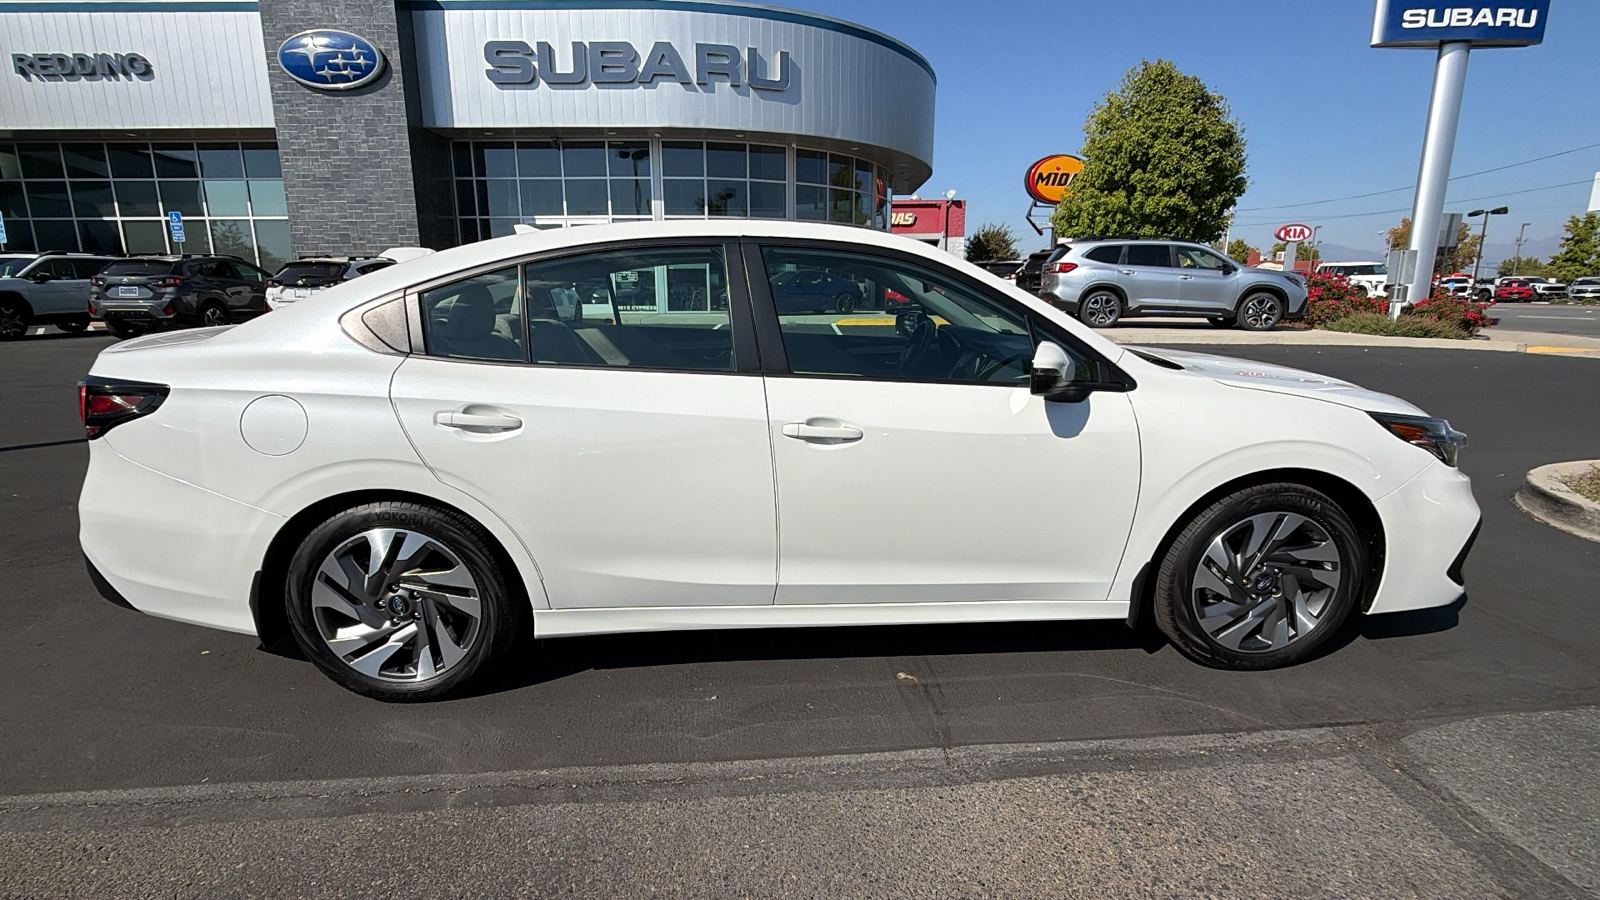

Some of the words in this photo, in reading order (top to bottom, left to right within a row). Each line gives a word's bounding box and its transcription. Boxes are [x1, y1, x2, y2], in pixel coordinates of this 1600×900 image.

[1402, 8, 1538, 28] SUBARU
[11, 53, 146, 75] REDDING
[483, 40, 791, 92] SUBARU
[1284, 227, 1306, 240] KIA
